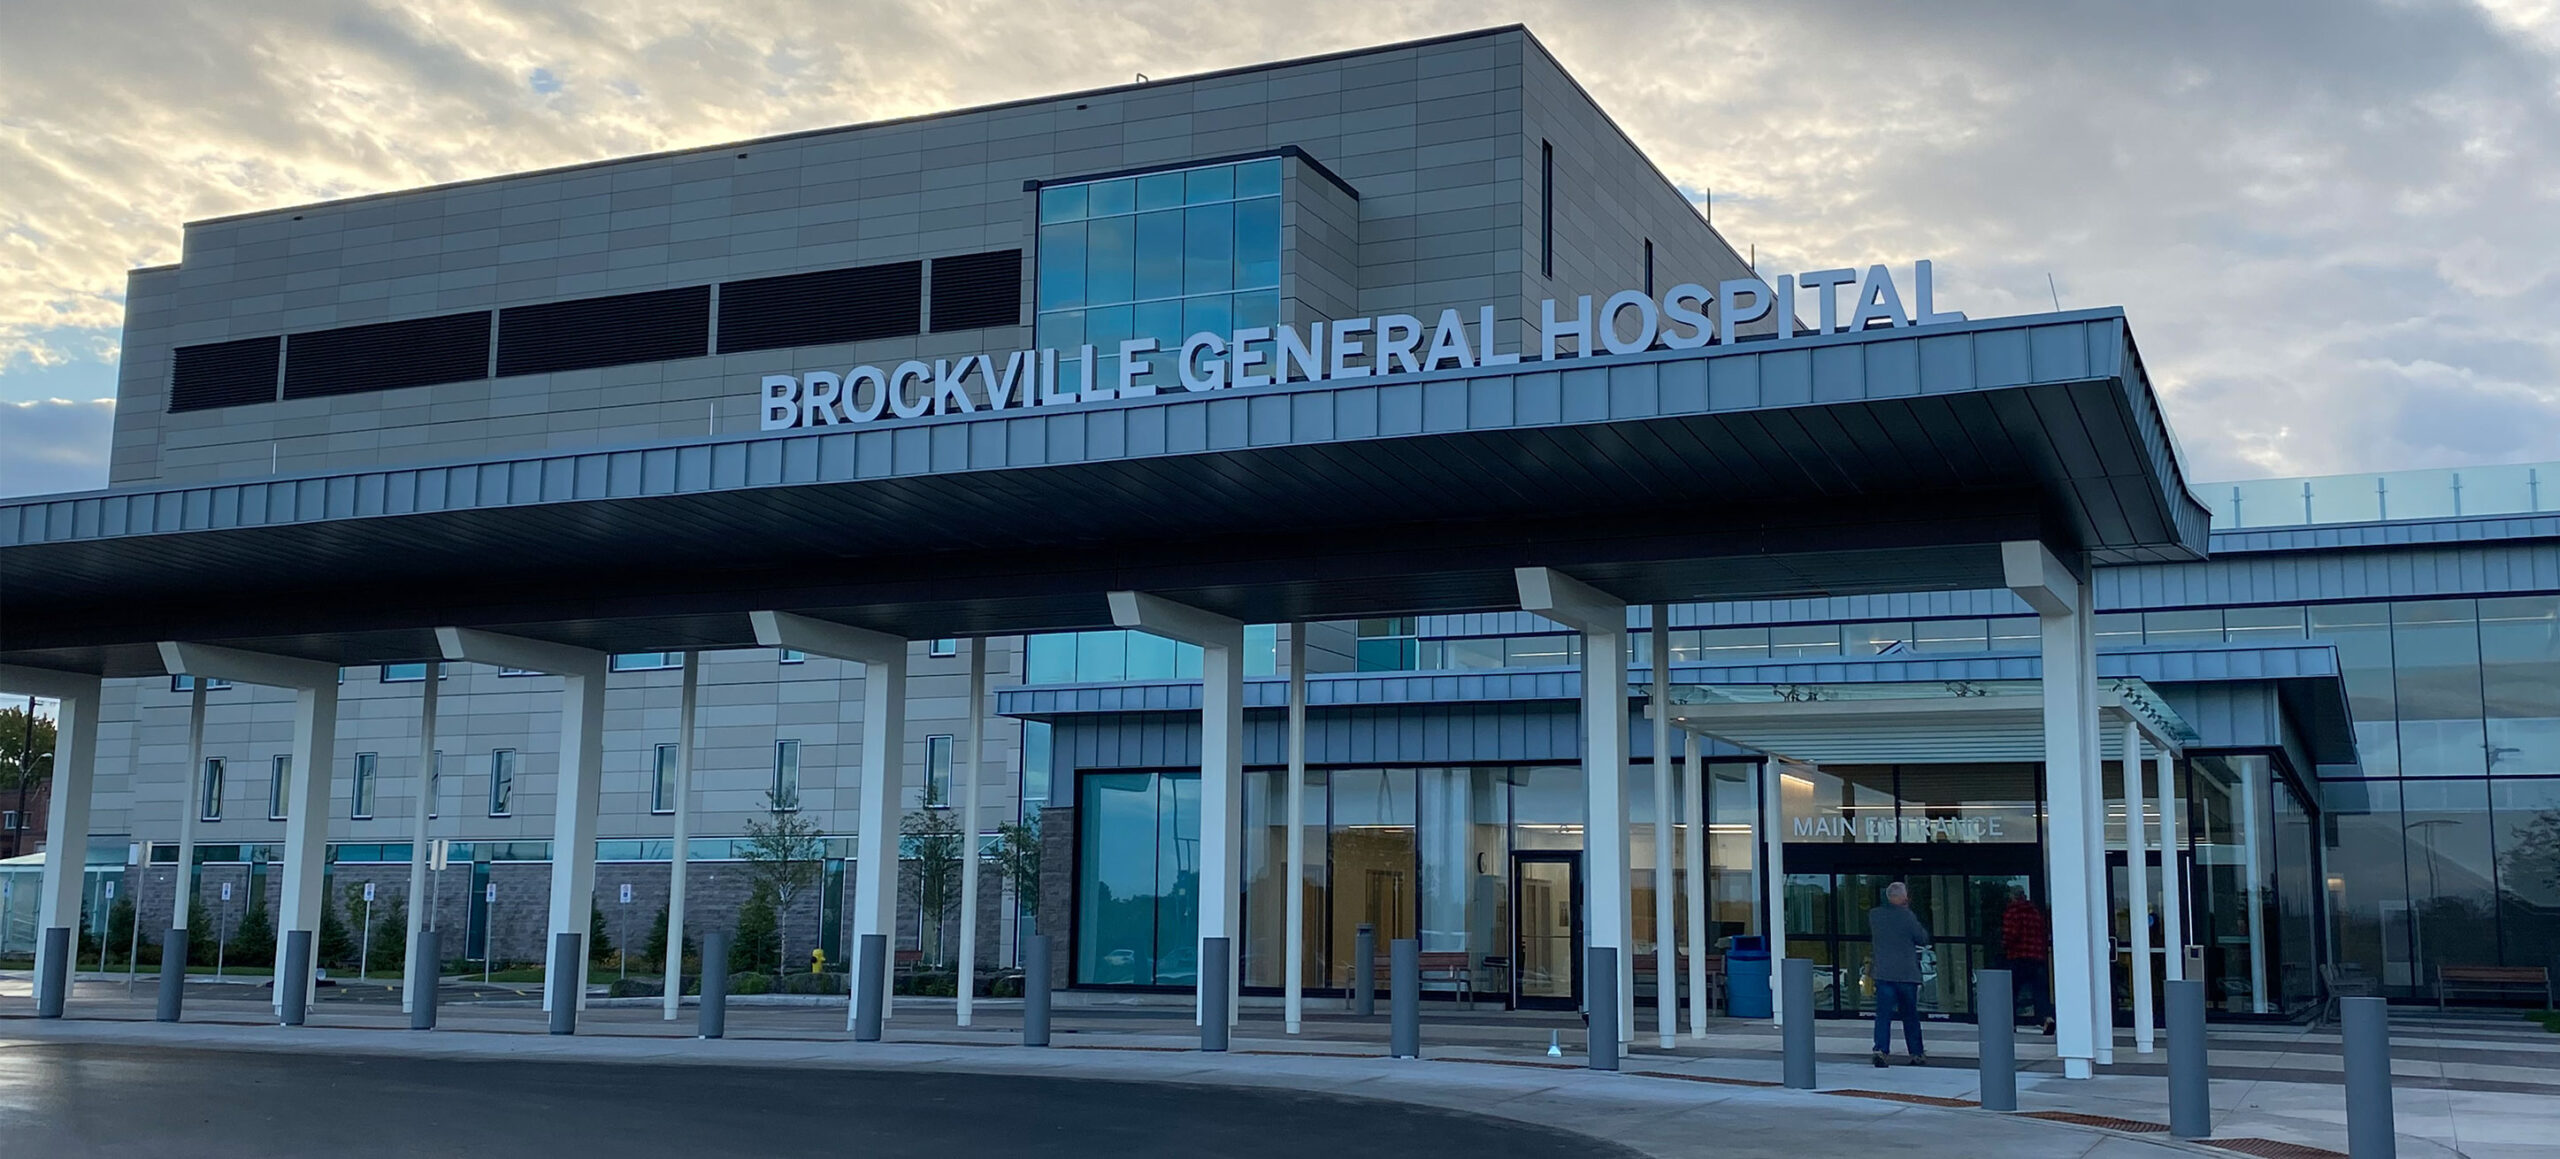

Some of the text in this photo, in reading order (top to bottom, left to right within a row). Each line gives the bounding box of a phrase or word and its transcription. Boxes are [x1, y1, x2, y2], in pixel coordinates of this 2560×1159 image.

[760, 259, 1966, 431] BROCKVILLE GENERAL HOSPITAL
[1793, 816, 2003, 836] MAIN ENTRANCE
